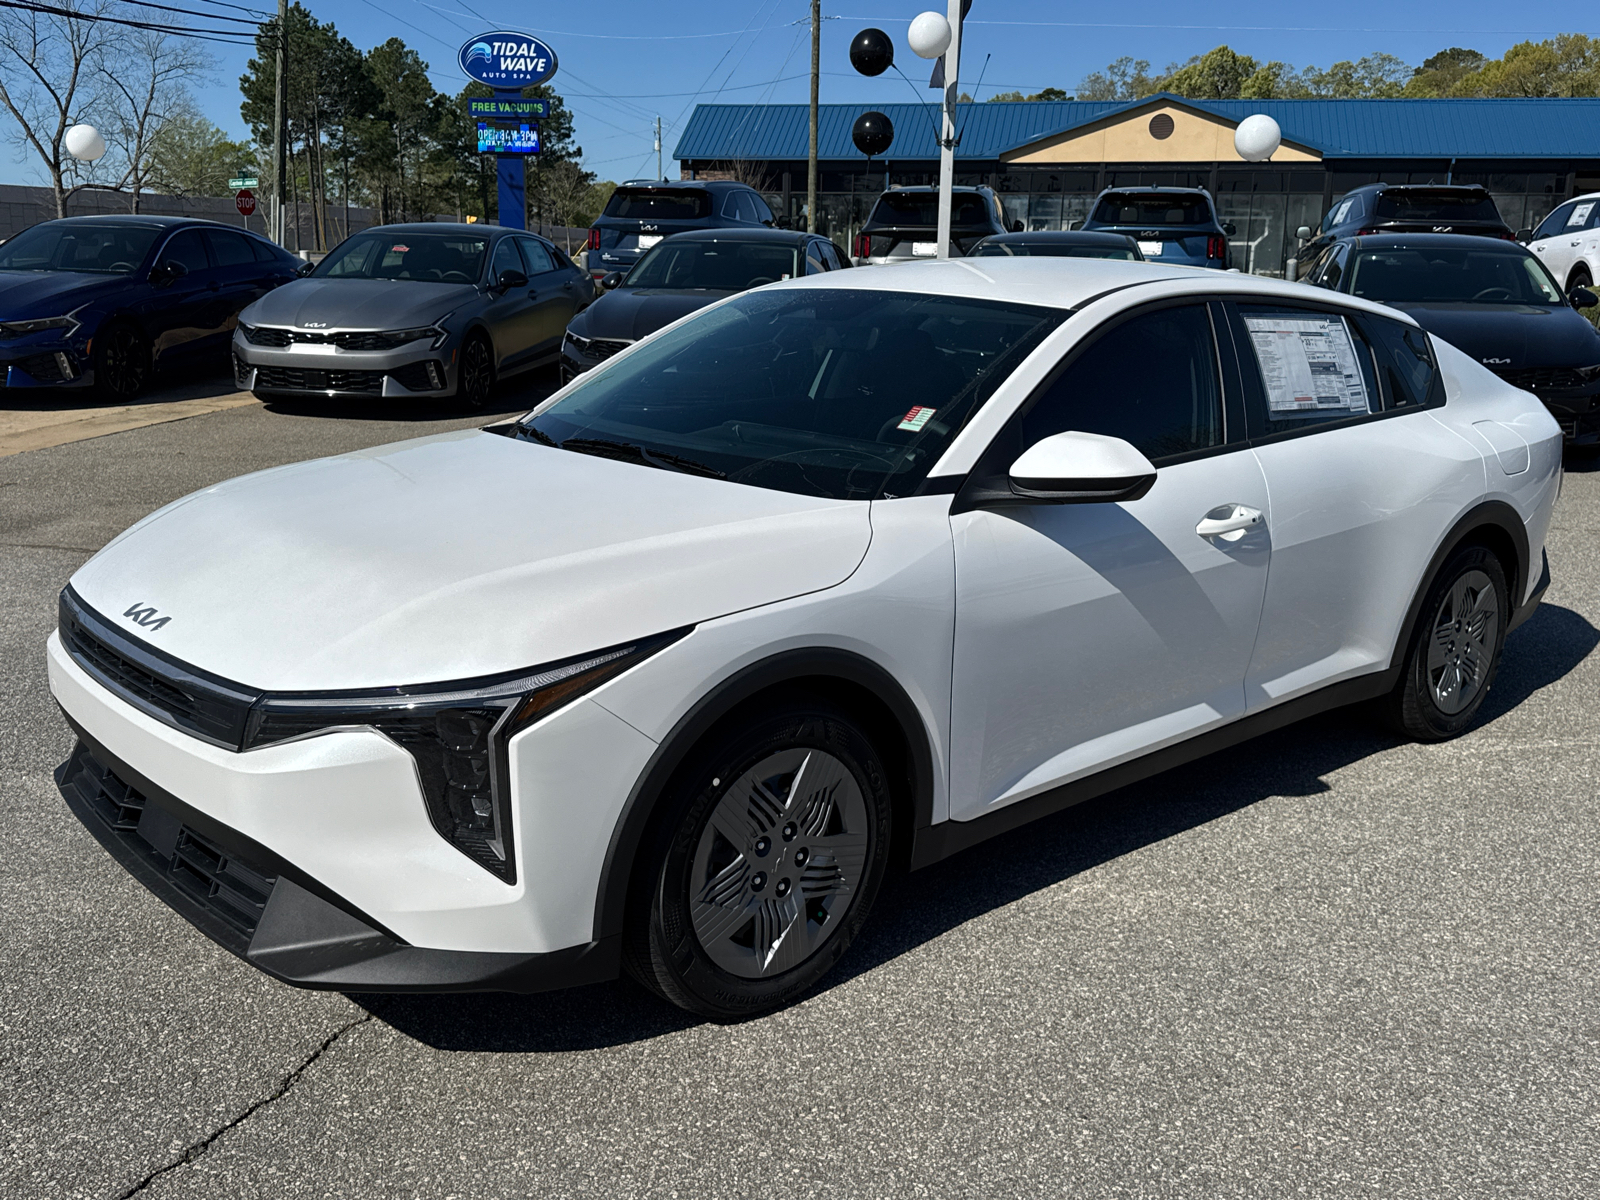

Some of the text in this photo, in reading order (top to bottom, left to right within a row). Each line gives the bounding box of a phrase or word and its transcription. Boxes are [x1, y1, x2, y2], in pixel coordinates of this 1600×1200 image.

[492, 42, 536, 56] TIDAL
[500, 57, 546, 71] WAVE
[472, 102, 543, 113] FREE VACUUMS
[237, 197, 255, 208] STOP
[122, 601, 172, 632] KIA
